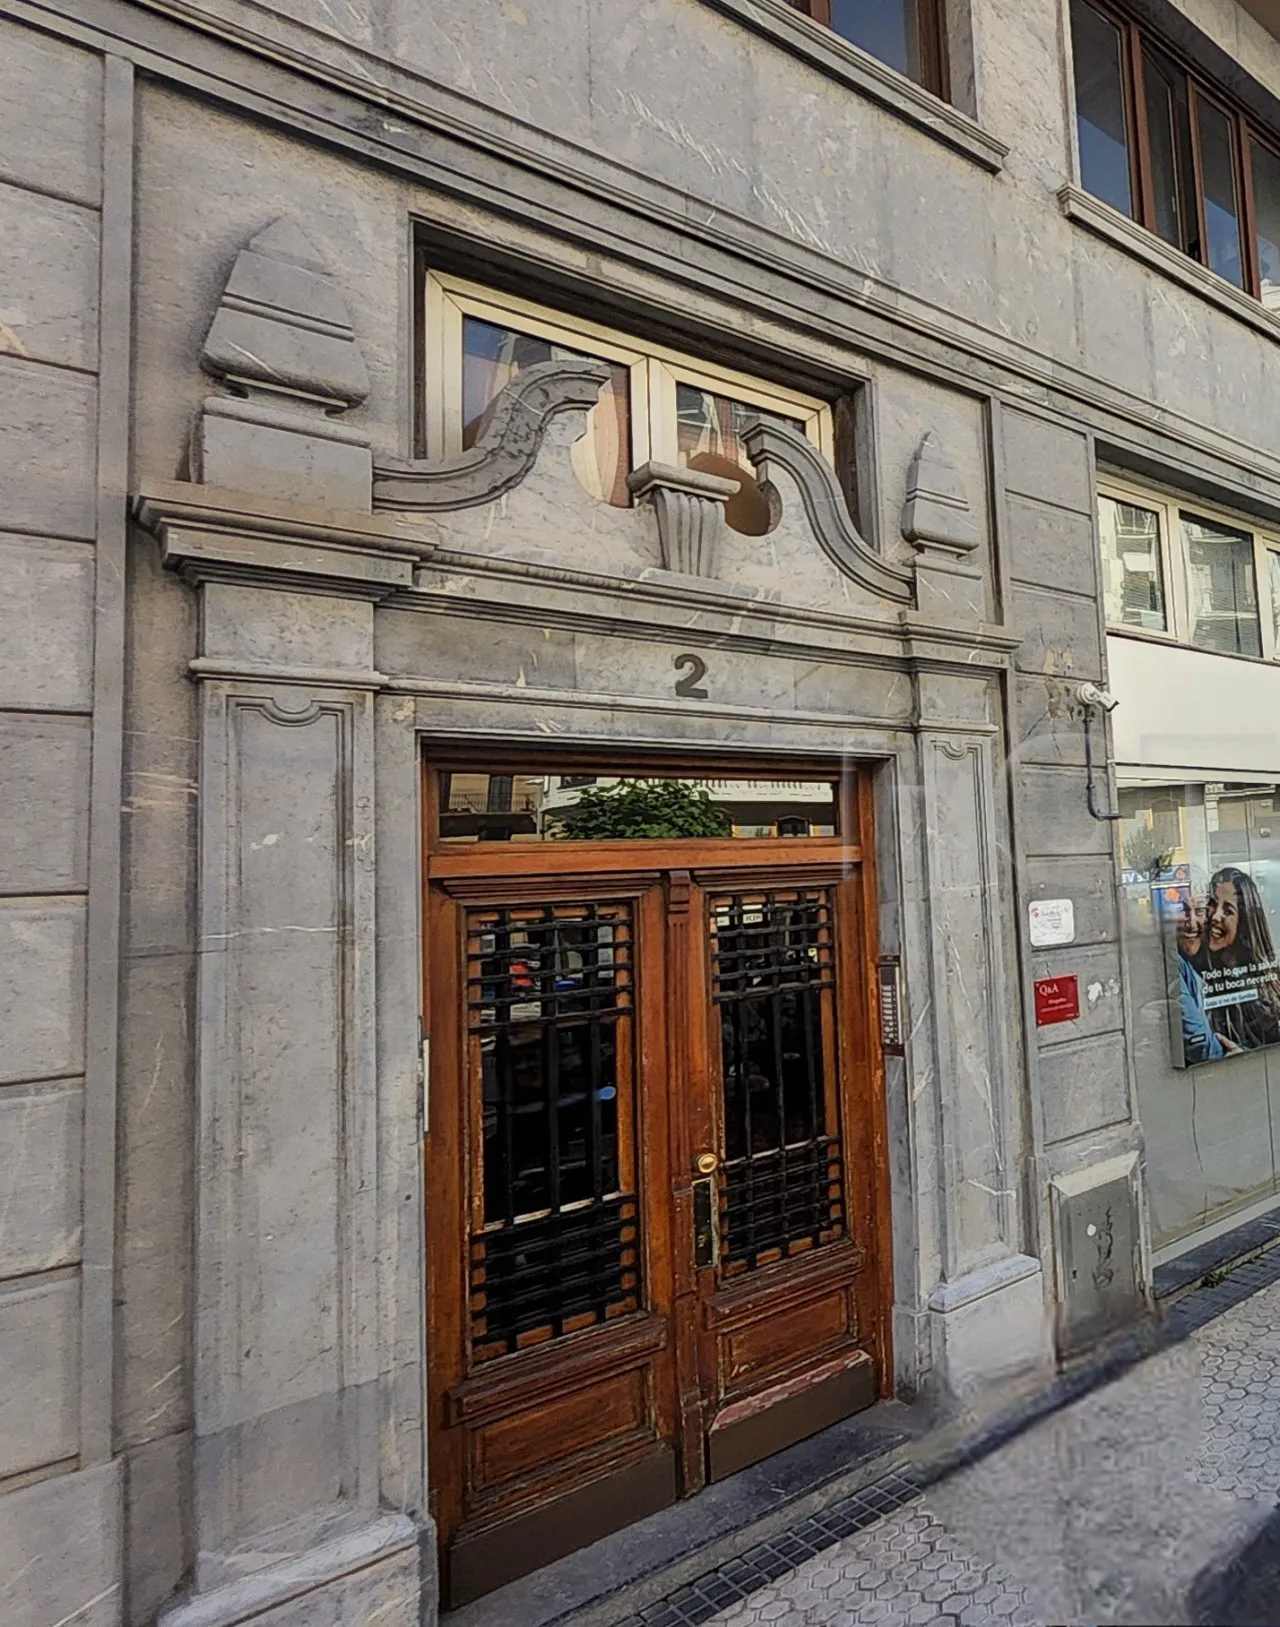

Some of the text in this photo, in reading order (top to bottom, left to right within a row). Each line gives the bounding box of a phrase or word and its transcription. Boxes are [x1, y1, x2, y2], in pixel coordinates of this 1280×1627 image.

[674, 653, 708, 699] 2
[1201, 960, 1278, 980] Todo lo que la salud
[1039, 982, 1060, 996] Q&A
[1202, 972, 1278, 994] de tu boca necesita
